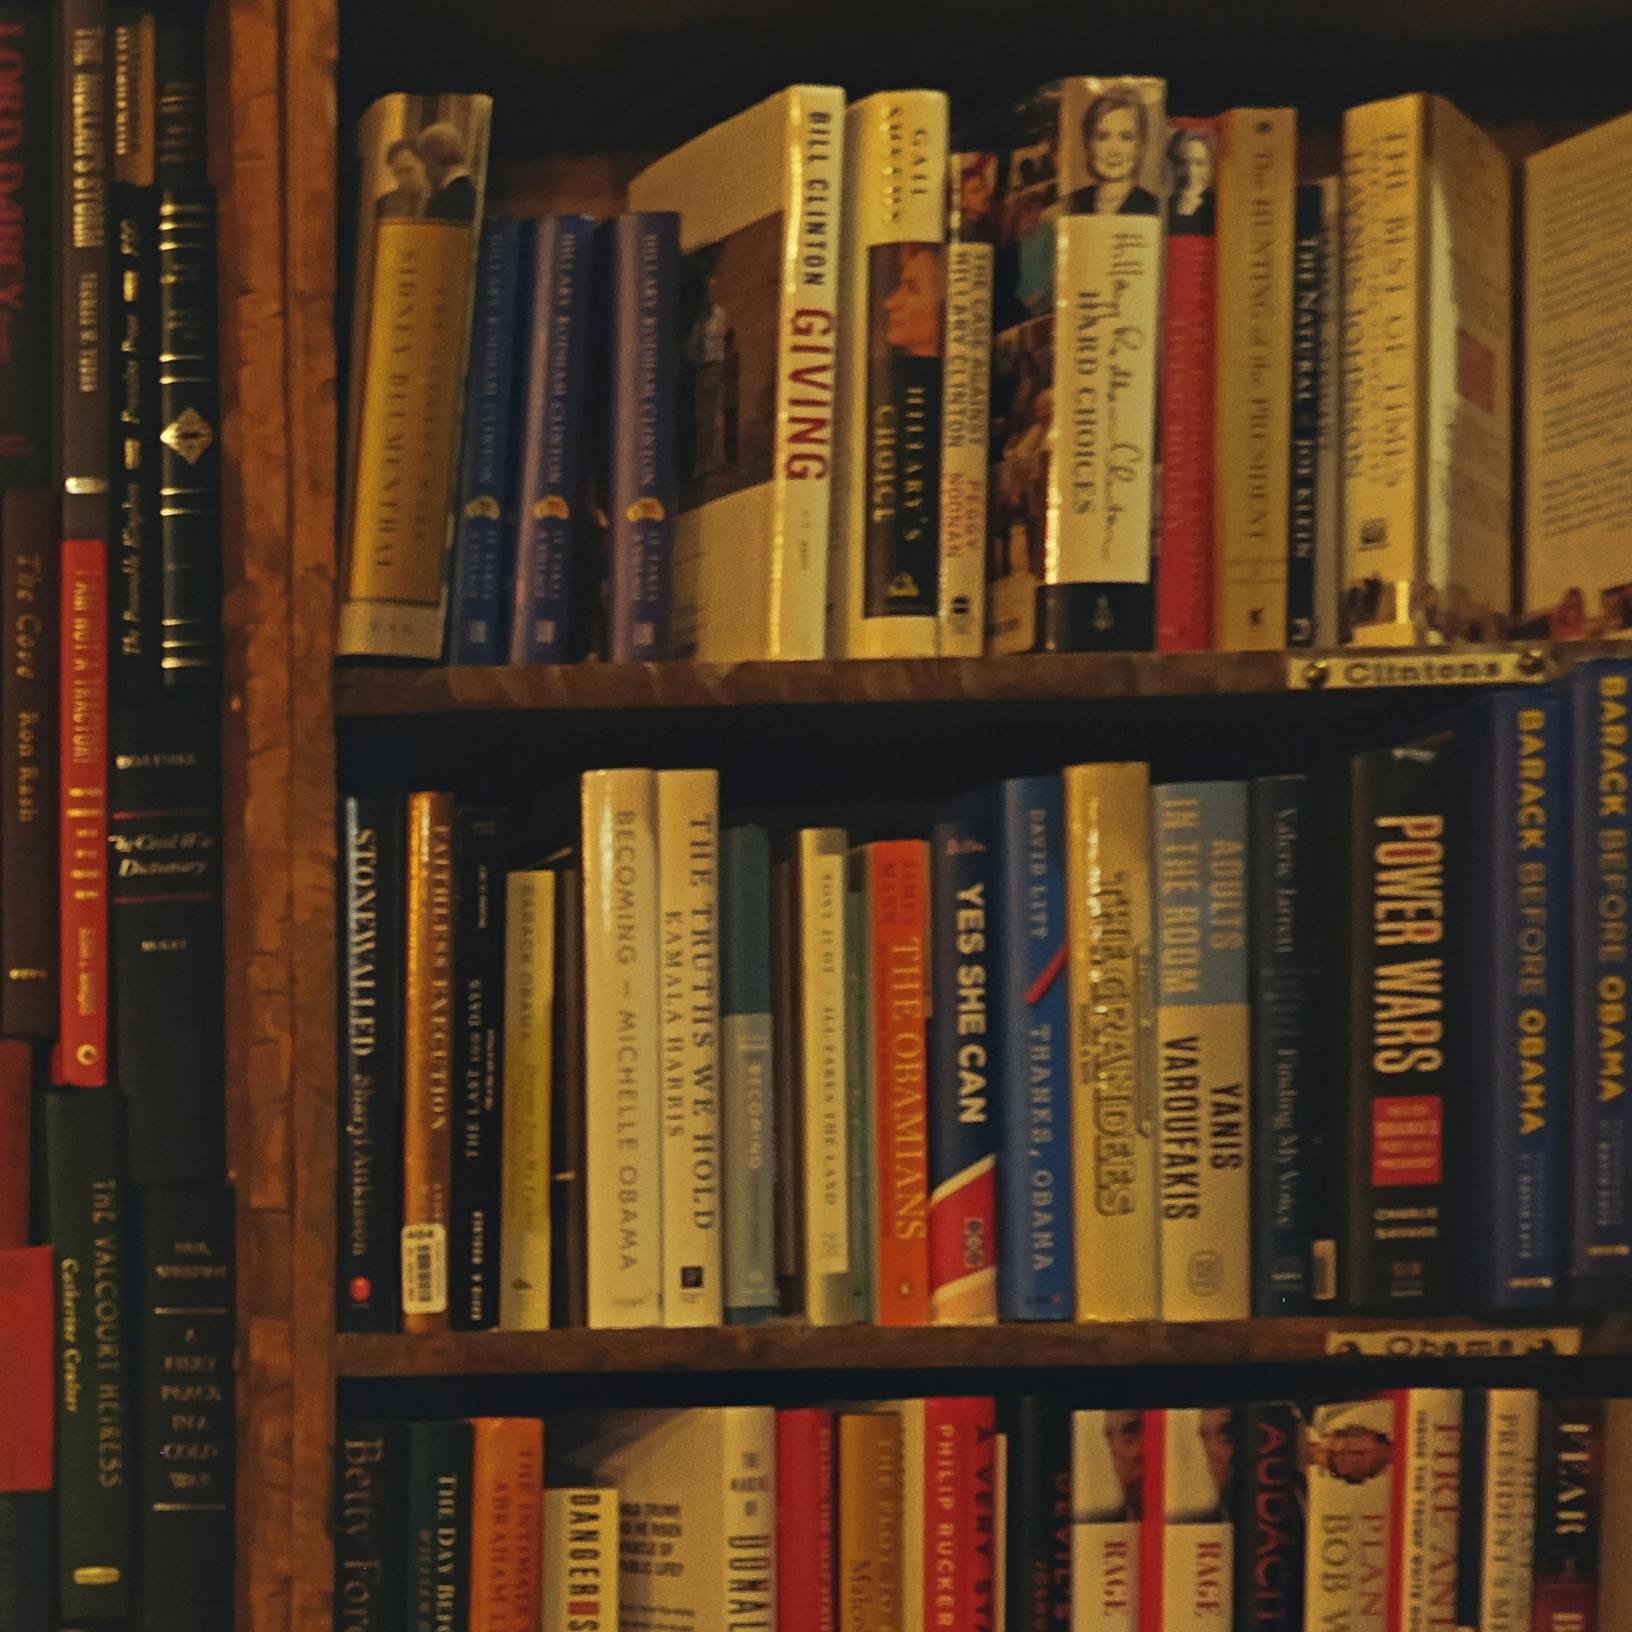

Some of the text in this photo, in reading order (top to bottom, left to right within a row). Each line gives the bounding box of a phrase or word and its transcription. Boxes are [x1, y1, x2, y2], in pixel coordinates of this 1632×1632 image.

[802, 111, 833, 286] BILL CLINTON
[785, 308, 833, 481] GIVING
[874, 403, 894, 523] CHOICE
[905, 386, 926, 541] HILLARY'S
[1072, 291, 1102, 515] HARD CHOICES
[1342, 661, 1498, 684] Clintons
[347, 829, 378, 1057] STONEWALLED
[1162, 840, 1200, 993] THE ROOM
[1209, 839, 1244, 951] ADULTS
[1374, 815, 1444, 1075] POWER WARS
[1517, 709, 1546, 1134] BARACK BEFORE OBAMA
[1597, 676, 1629, 1101] BARACK BEFORE OBAMA
[614, 809, 637, 1271] BECOMING MICHELLE OBAMA
[663, 910, 683, 1139] KAMALA HARRIS
[688, 814, 716, 1231] THE TRUTHS WE HOLD
[953, 881, 988, 1124] YES SHE CAN
[891, 940, 926, 1241] THE OBAMIANS
[1163, 1037, 1201, 1219] VAROUFAKIS
[1211, 1082, 1241, 1169] YANIS
[1033, 1170, 1053, 1271] OBAMA
[92, 1227, 123, 1487] VALCOURT HEIRESS
[1386, 1338, 1513, 1357] Obama
[343, 1437, 384, 1535] Betty
[935, 1424, 954, 1510] PHILIP
[1556, 1423, 1589, 1535] FEAR
[569, 1493, 600, 1598] DANGER
[934, 1520, 955, 1627] RUCKER
[1101, 1540, 1127, 1617] RAGE
[1194, 1540, 1222, 1617] RAGE
[1319, 1513, 1350, 1596] BOB
